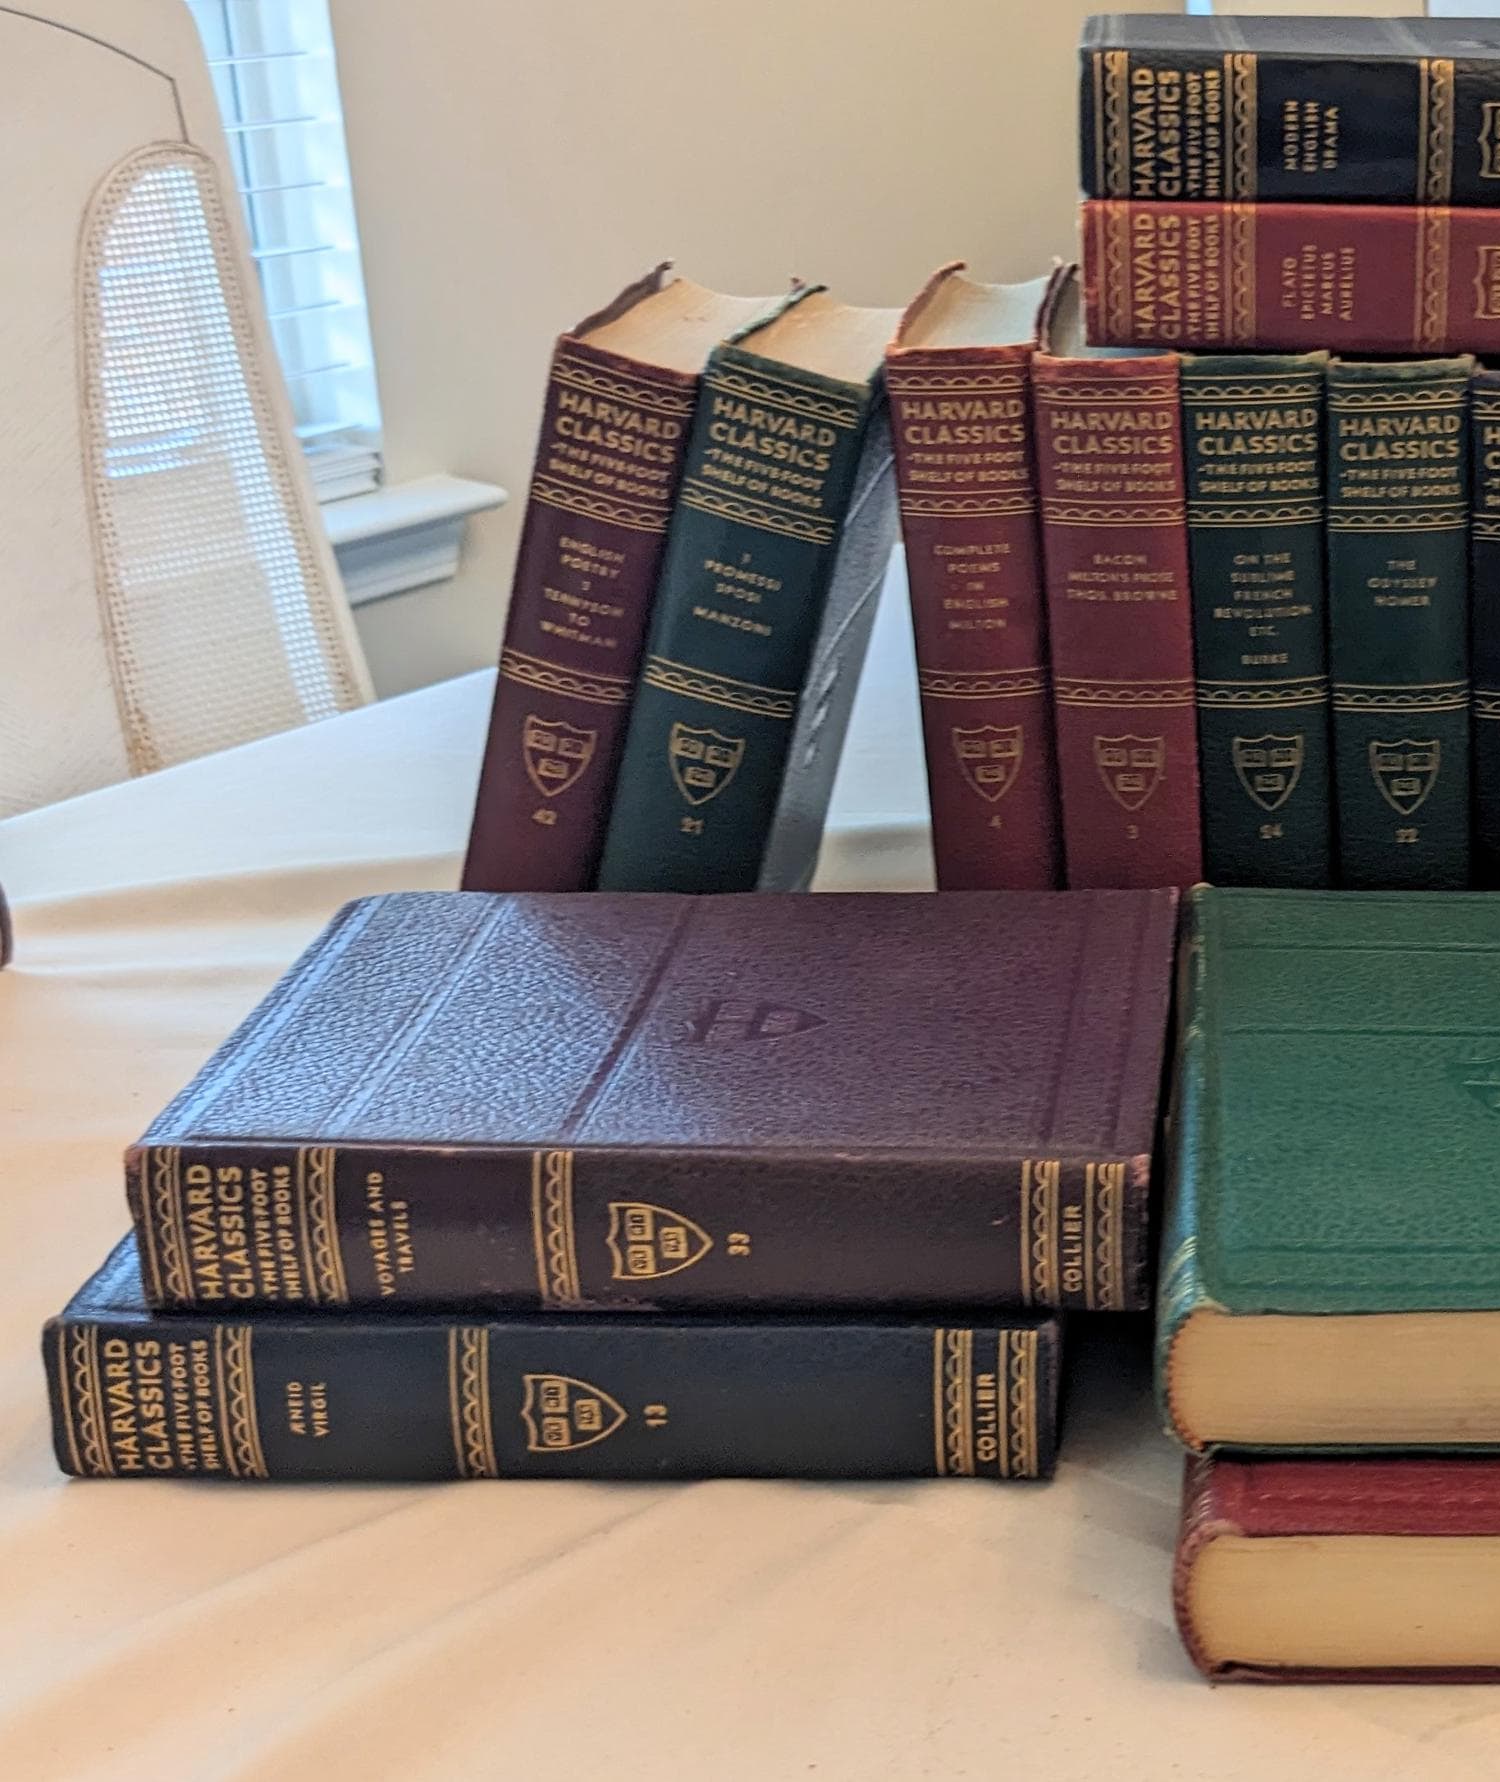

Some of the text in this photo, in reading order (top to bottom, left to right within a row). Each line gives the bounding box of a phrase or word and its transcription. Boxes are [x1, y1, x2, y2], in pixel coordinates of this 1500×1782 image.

[1131, 67, 1154, 196] HARVARD
[1157, 70, 1181, 196] CLASSICS
[1283, 100, 1299, 169] MODERN
[1303, 101, 1319, 171] ENGLISH
[1323, 106, 1338, 168] DRAMA
[1133, 213, 1156, 338] HARVARD
[1158, 214, 1180, 338] CLASSICS
[1281, 256, 1297, 307] PLATO
[1301, 244, 1316, 319] EPICTETUS
[1320, 252, 1334, 314] MARCUS
[1339, 247, 1354, 320] AURELIUS
[558, 392, 681, 440] HARVARD
[713, 397, 837, 447] HARVARD
[901, 400, 1025, 420] HARVARD
[1051, 411, 1173, 430] HARVARD
[1196, 409, 1318, 430] HARVARD
[1339, 415, 1461, 436] HARVARD
[555, 416, 676, 464] CLASSICS
[709, 422, 831, 471] CLASSICS
[904, 424, 1026, 445] CLASSICS
[1052, 436, 1174, 454] CLASSICS
[1198, 433, 1318, 456] CLASSICS
[1340, 439, 1460, 461] CLASSICS
[559, 537, 626, 563] ENGLISH
[560, 555, 620, 578] POETRY
[948, 563, 1000, 573] POEMS
[1093, 554, 1146, 565] BACON
[1233, 552, 1291, 565] ON THE
[1388, 560, 1416, 570] THE
[1230, 570, 1296, 582] SUBLIME
[1234, 589, 1294, 600] FRENCH
[1367, 577, 1438, 588] ODYSSEY
[569, 612, 591, 627] TO
[692, 605, 772, 637] MANZONI
[944, 599, 1009, 609] ENGLISH
[1214, 605, 1312, 618] REVOLUTION
[1374, 596, 1430, 606] HOMER
[948, 619, 1006, 630] MILTON
[1241, 653, 1288, 664] BURKE
[185, 1164, 225, 1298] HARVARD
[216, 1165, 255, 1298] CLASSICS
[272, 1165, 303, 1298] SHELF OF BOOKS
[366, 1171, 396, 1294] VOYAGES AND
[390, 1200, 414, 1272] TRAVELS
[727, 1232, 751, 1256] 33
[1063, 1204, 1083, 1292] COLLIER
[103, 1338, 143, 1469] HARVARD
[134, 1340, 173, 1469] CLASSICS
[190, 1339, 221, 1469] SHELF OF BOOKS
[310, 1381, 330, 1435] VIRGIL
[643, 1404, 668, 1428] 13
[977, 1372, 997, 1461] COLLIER
